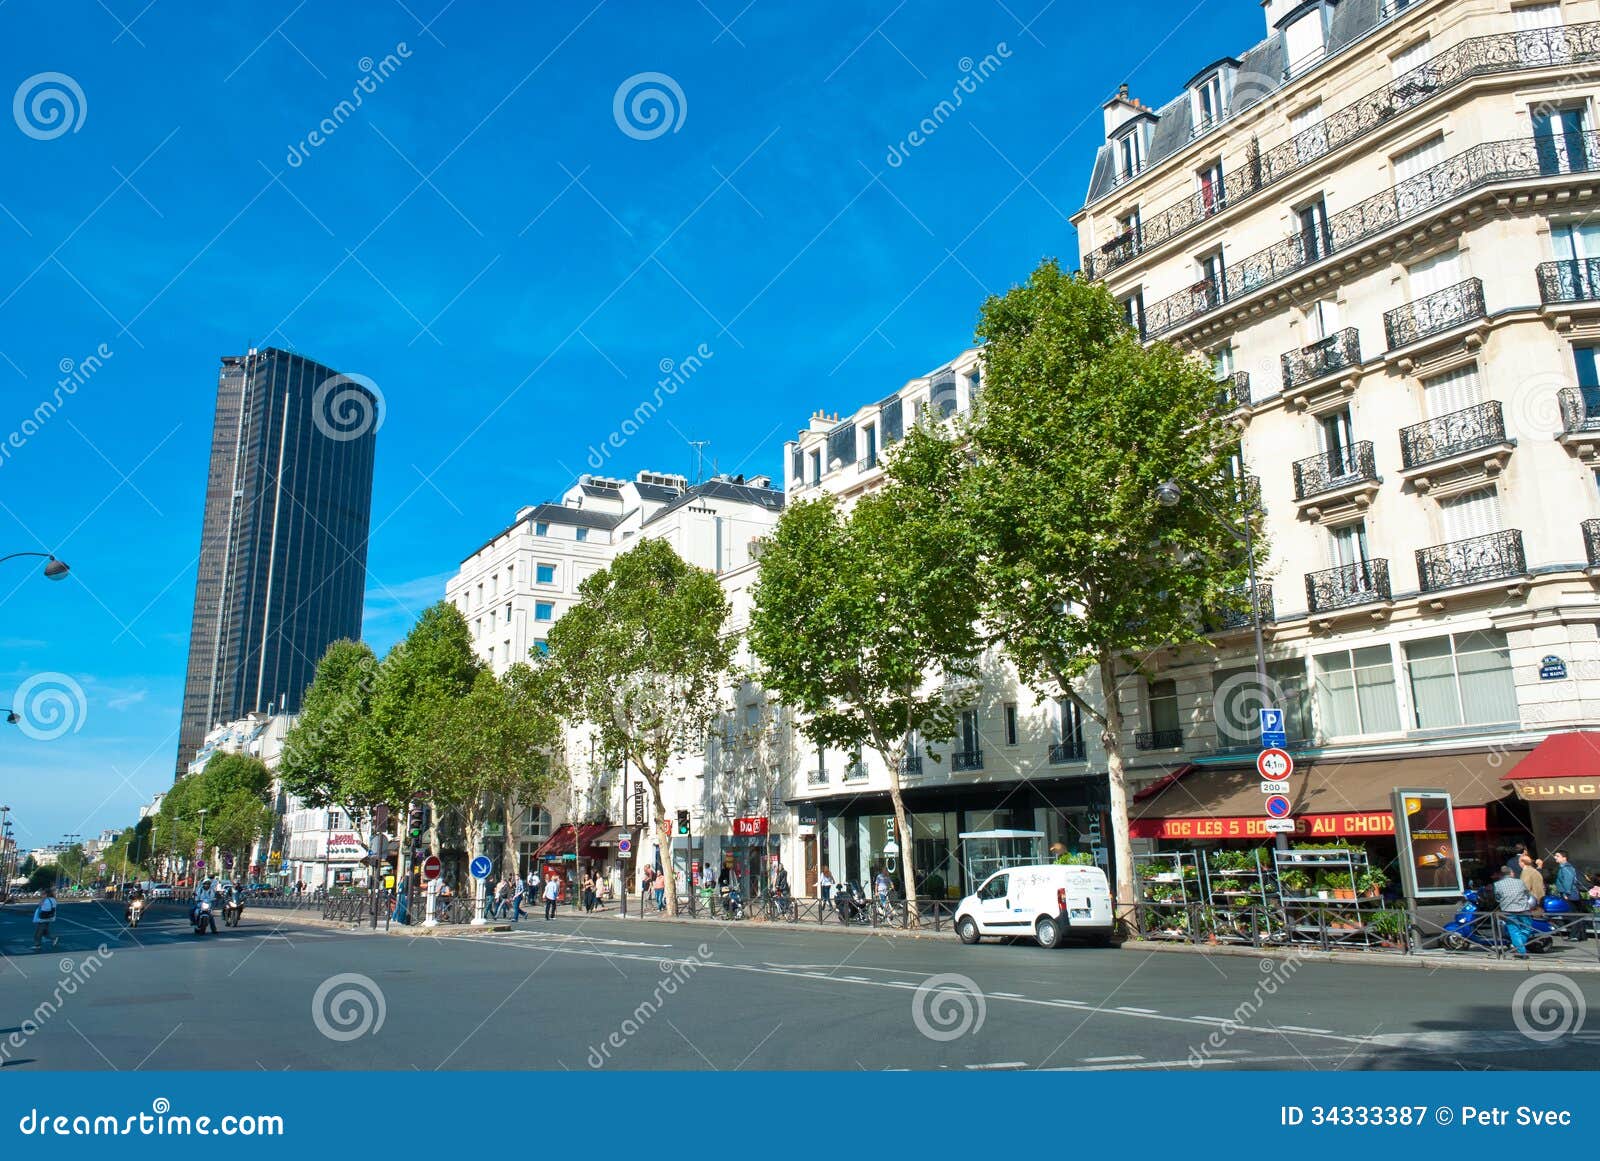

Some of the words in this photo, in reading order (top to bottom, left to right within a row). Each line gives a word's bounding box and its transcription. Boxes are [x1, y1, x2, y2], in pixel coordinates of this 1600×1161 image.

[1266, 713, 1277, 729] P
[1197, 821, 1223, 835] LES
[1229, 820, 1240, 835] 5
[1313, 817, 1336, 833] AU
